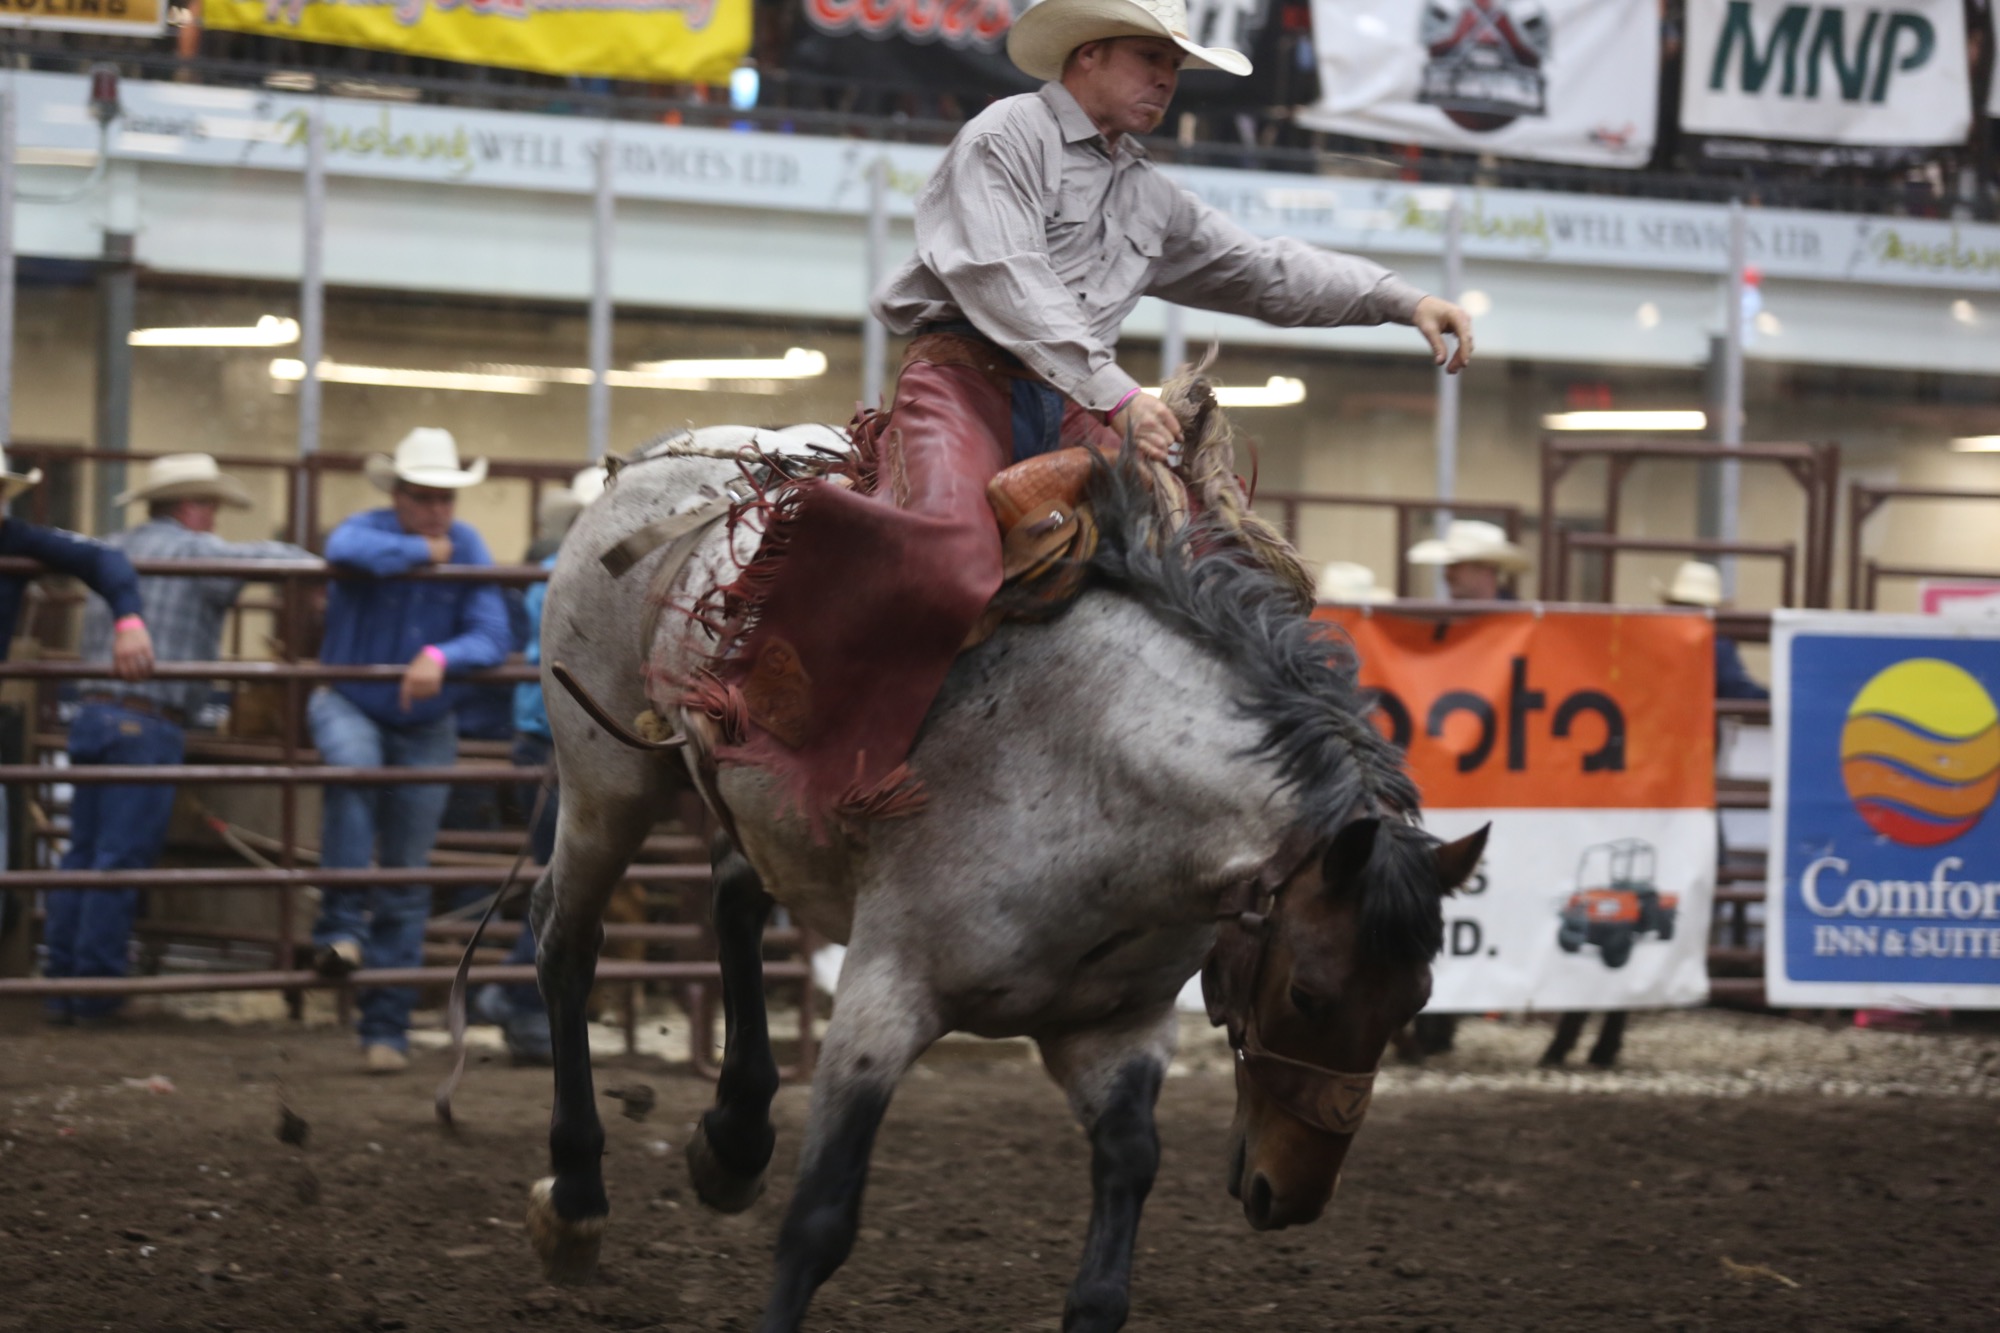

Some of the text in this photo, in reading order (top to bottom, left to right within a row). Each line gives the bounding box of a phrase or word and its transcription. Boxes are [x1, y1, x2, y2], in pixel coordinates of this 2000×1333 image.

[1708, 0, 1936, 104] MNP
[475, 131, 565, 168] WELL
[578, 137, 733, 180] SRVICES
[1553, 211, 1625, 247] WELL
[1639, 218, 1766, 252] SERVICS
[1801, 856, 2000, 919] Comfor
[1813, 924, 1880, 957] INN
[1882, 928, 1906, 958] &
